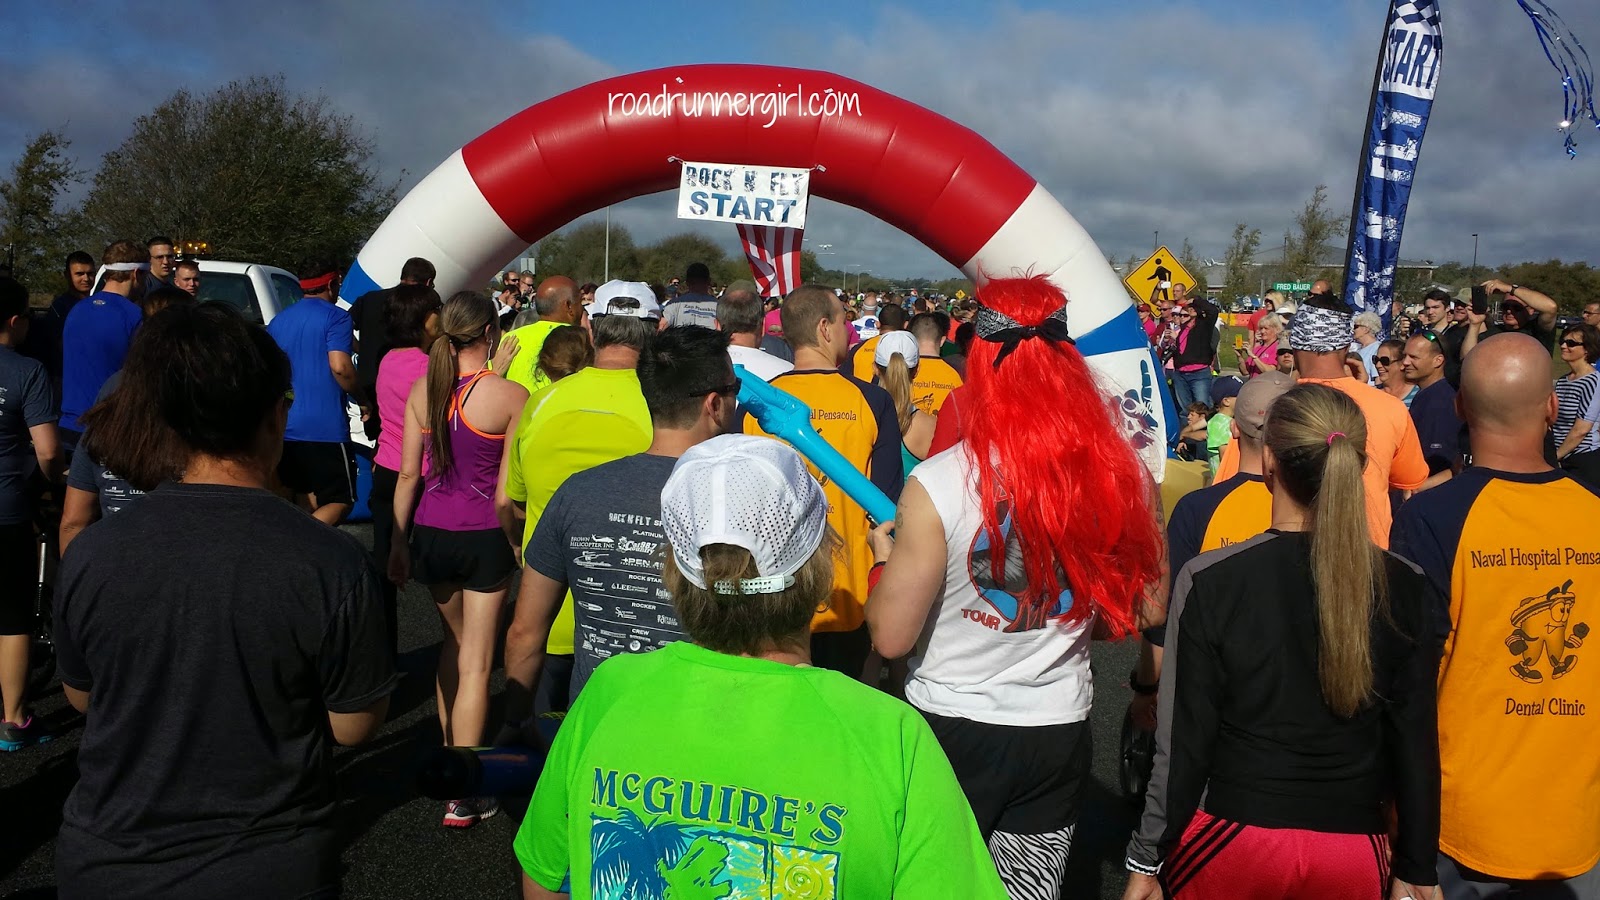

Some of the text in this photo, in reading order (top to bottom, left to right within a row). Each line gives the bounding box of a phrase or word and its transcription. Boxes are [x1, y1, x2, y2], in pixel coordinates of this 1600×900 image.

[1381, 28, 1442, 90] START
[685, 166, 803, 197] ROCK N FLY
[689, 190, 797, 224] START
[1292, 283, 1311, 291] BAUER
[912, 381, 931, 390] ospital
[818, 409, 857, 421] Pensacola
[608, 512, 627, 523] ROCK
[632, 529, 664, 539] PLATINUM
[1470, 547, 1600, 570] Naval Hospital Pensa
[628, 574, 663, 584] ROCK STAR
[631, 602, 657, 610] ROCKER
[961, 608, 1001, 631] TOUR
[631, 628, 650, 636] CREW
[1504, 697, 1586, 717] Dental Clinic
